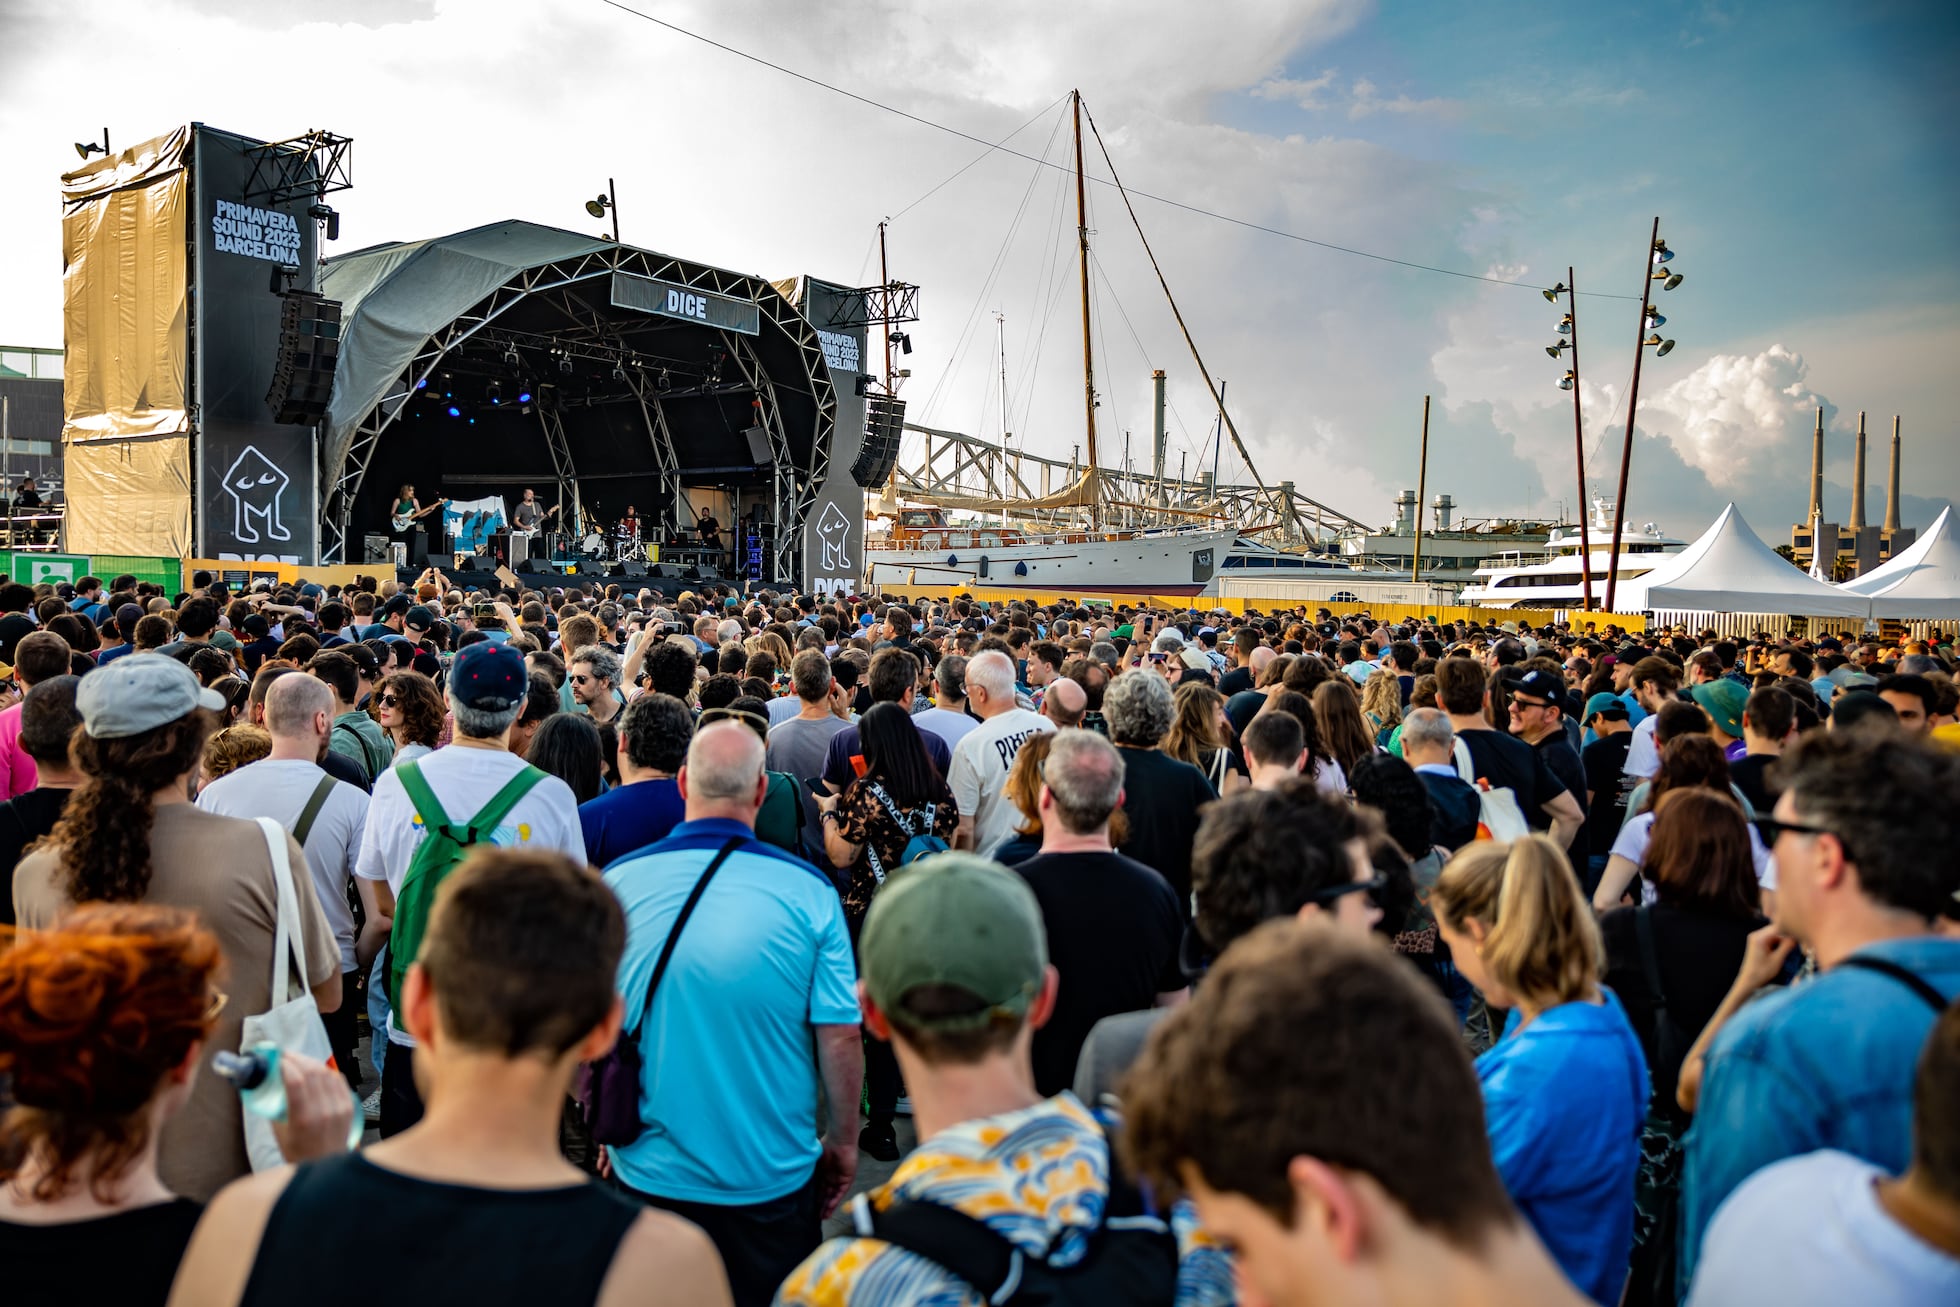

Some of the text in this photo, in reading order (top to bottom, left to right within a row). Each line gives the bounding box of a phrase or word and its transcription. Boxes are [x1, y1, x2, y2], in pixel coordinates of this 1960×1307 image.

[212, 216, 301, 249] SOUND 2023
[216, 199, 299, 233] PRIMAVERA
[215, 233, 301, 266] BARCELONA
[668, 289, 707, 319] DICE
[840, 346, 860, 361] 2023
